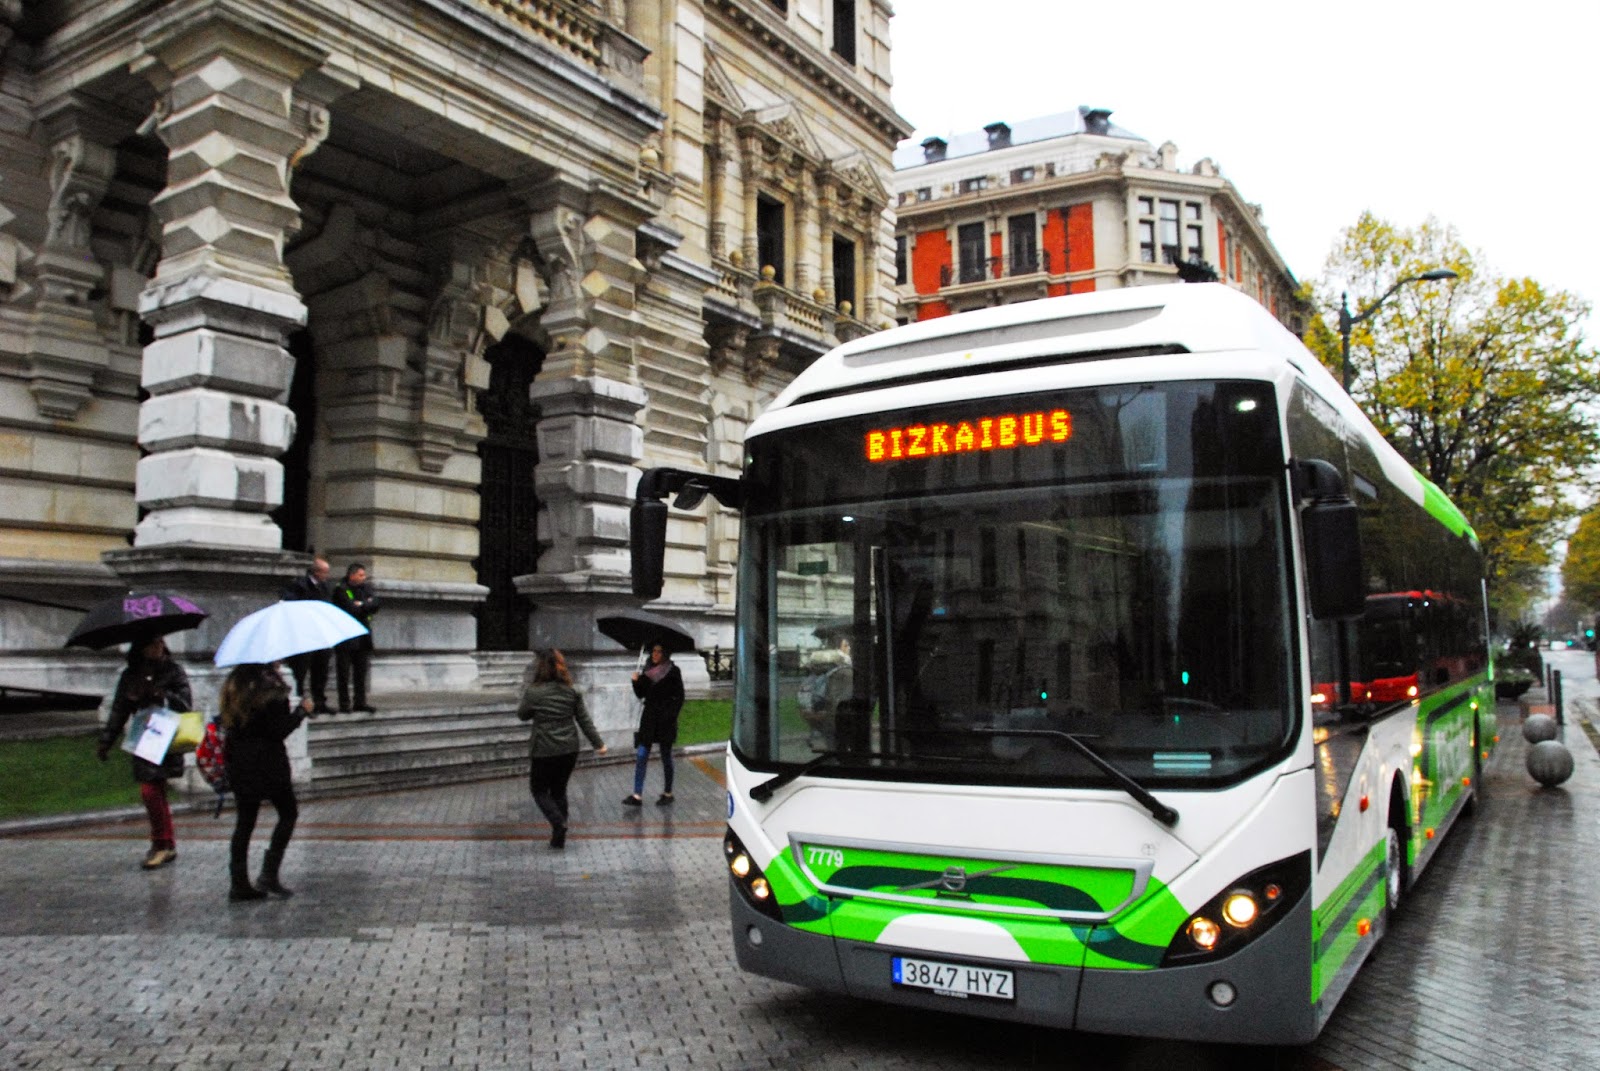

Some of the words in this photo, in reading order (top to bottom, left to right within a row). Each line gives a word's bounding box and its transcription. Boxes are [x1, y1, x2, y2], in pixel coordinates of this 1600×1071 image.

[867, 410, 1070, 461] BIZKAIBUS
[808, 847, 844, 868] 7779
[905, 962, 958, 989] 3847
[966, 969, 1009, 996] HYZ
